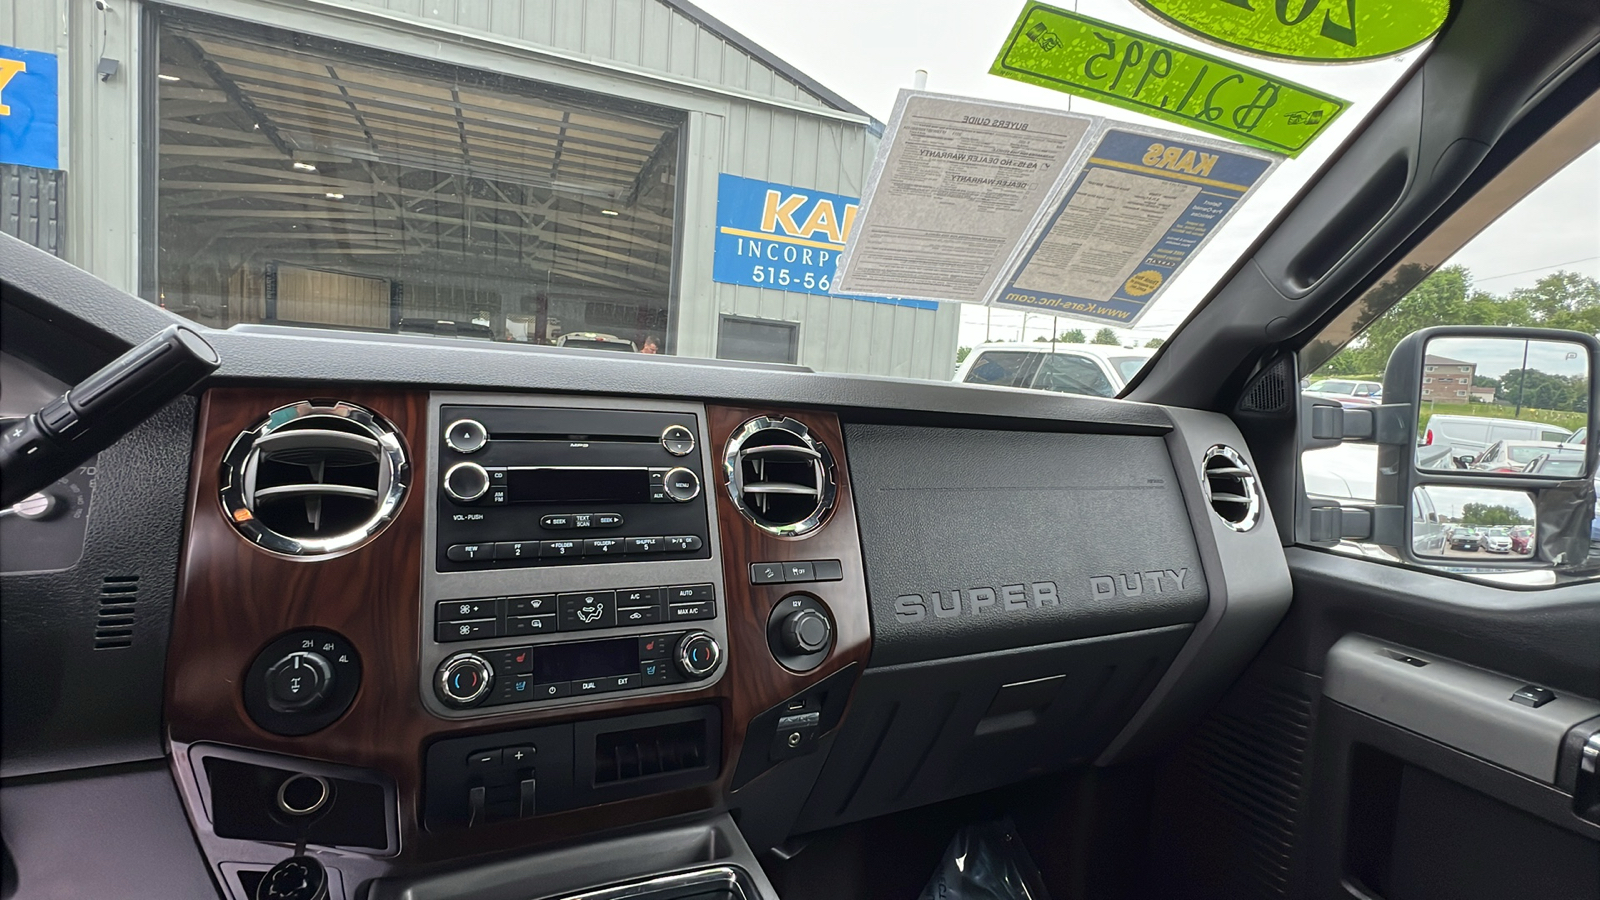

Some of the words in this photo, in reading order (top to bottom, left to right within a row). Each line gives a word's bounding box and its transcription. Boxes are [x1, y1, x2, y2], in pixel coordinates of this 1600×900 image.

[893, 580, 1061, 624] SUPER
[1090, 567, 1189, 601] DUTY
[302, 640, 314, 648] 2H
[323, 643, 335, 651] 4H
[338, 655, 349, 663] 4L
